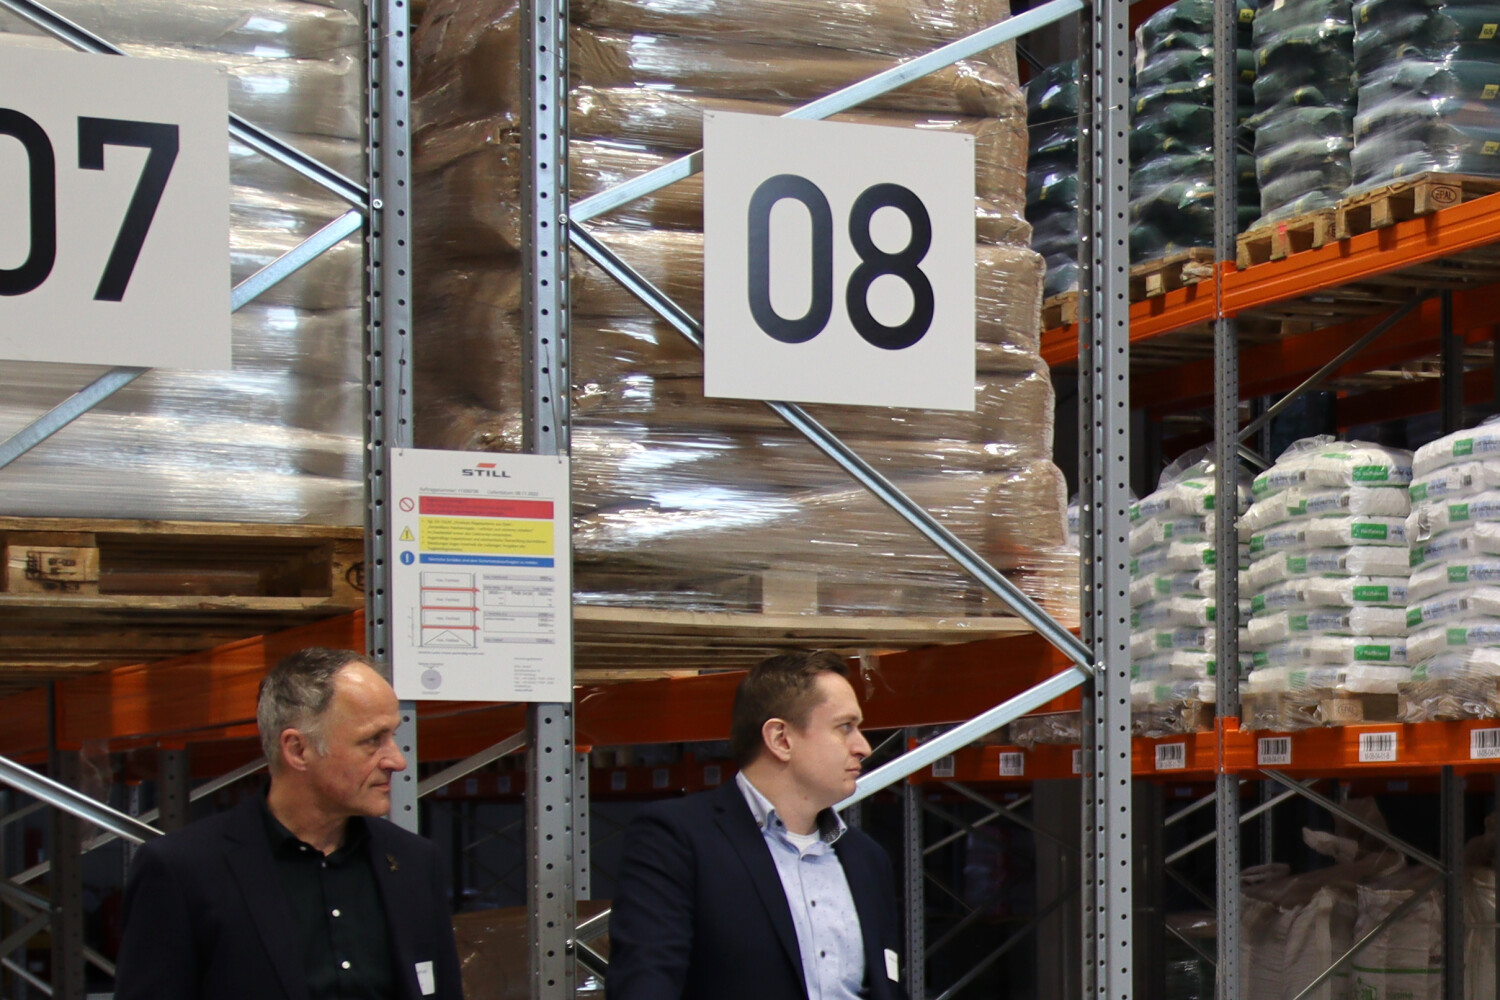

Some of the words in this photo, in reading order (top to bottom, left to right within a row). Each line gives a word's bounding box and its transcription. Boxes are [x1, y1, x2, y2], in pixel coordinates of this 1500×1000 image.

[1483, 27, 1494, 36] GS
[747, 173, 934, 350] 08
[462, 468, 511, 478] STILL
